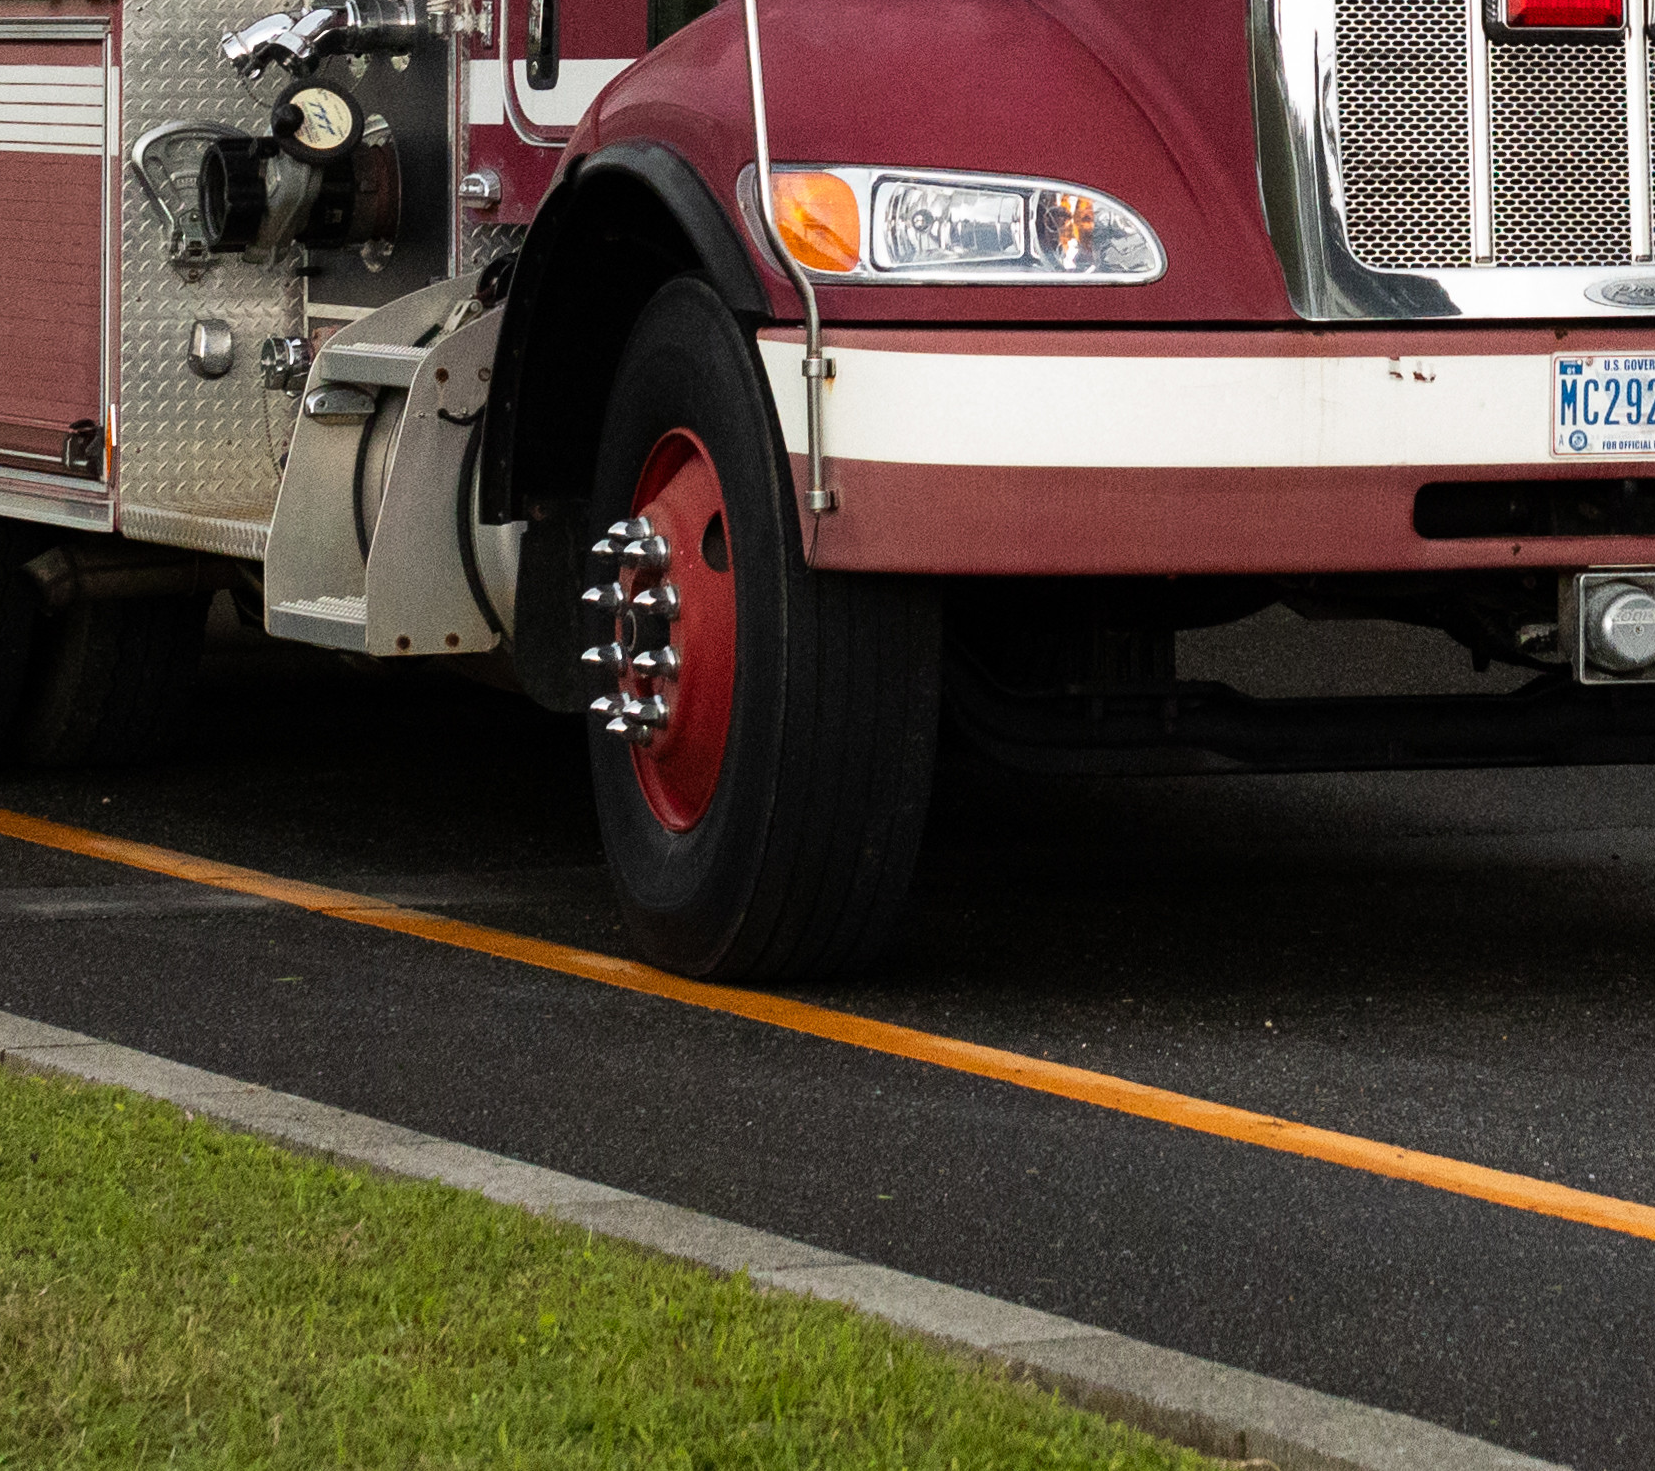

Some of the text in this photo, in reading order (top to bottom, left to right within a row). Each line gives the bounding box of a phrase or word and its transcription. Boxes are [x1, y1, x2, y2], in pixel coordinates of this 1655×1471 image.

[1604, 359, 1622, 371] U.S.
[1602, 440, 1617, 450] FOR
[1619, 440, 1652, 450] OFFICIAL
